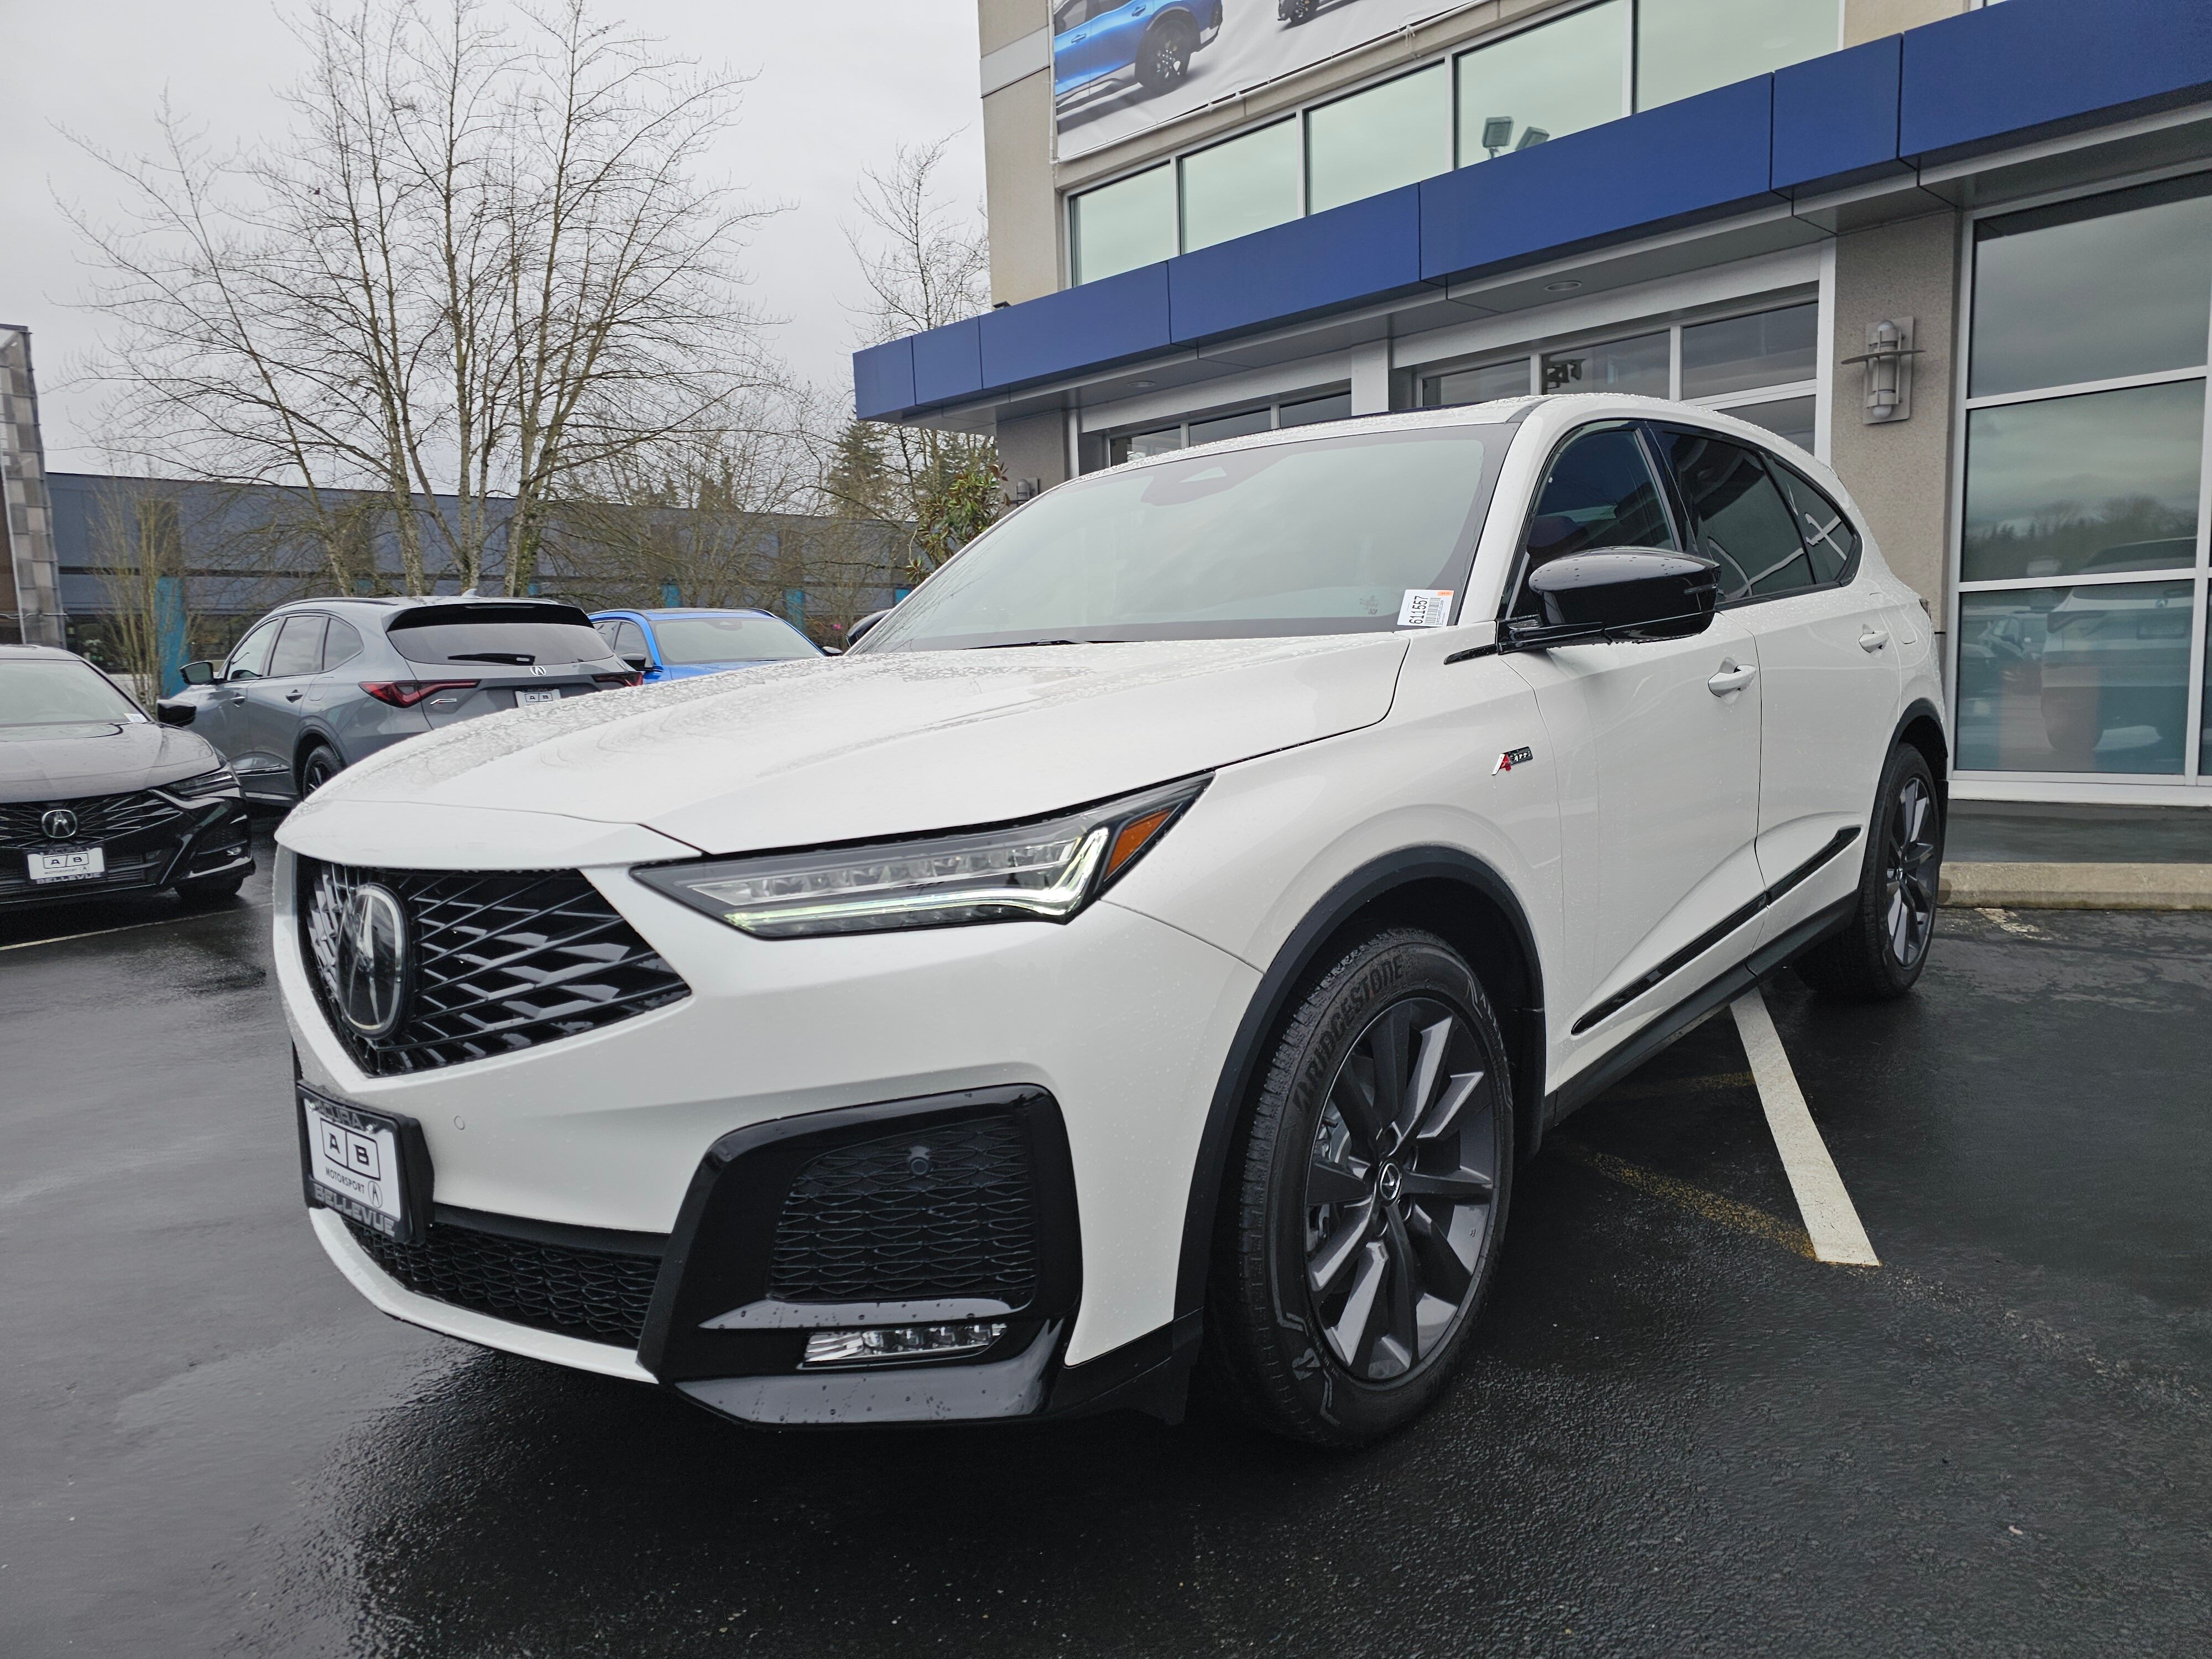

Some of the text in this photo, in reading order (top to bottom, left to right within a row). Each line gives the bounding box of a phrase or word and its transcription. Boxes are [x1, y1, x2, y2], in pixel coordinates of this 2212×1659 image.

[1408, 596, 1428, 624] 611557
[36, 873, 101, 884] BELLEVUE
[1292, 954, 1405, 1110] BRIDGESTONE
[316, 1100, 364, 1131] ACURA
[329, 1132, 369, 1166] A B
[325, 1167, 365, 1194] MOTORSPORT
[313, 1183, 395, 1238] BELLEVUE
